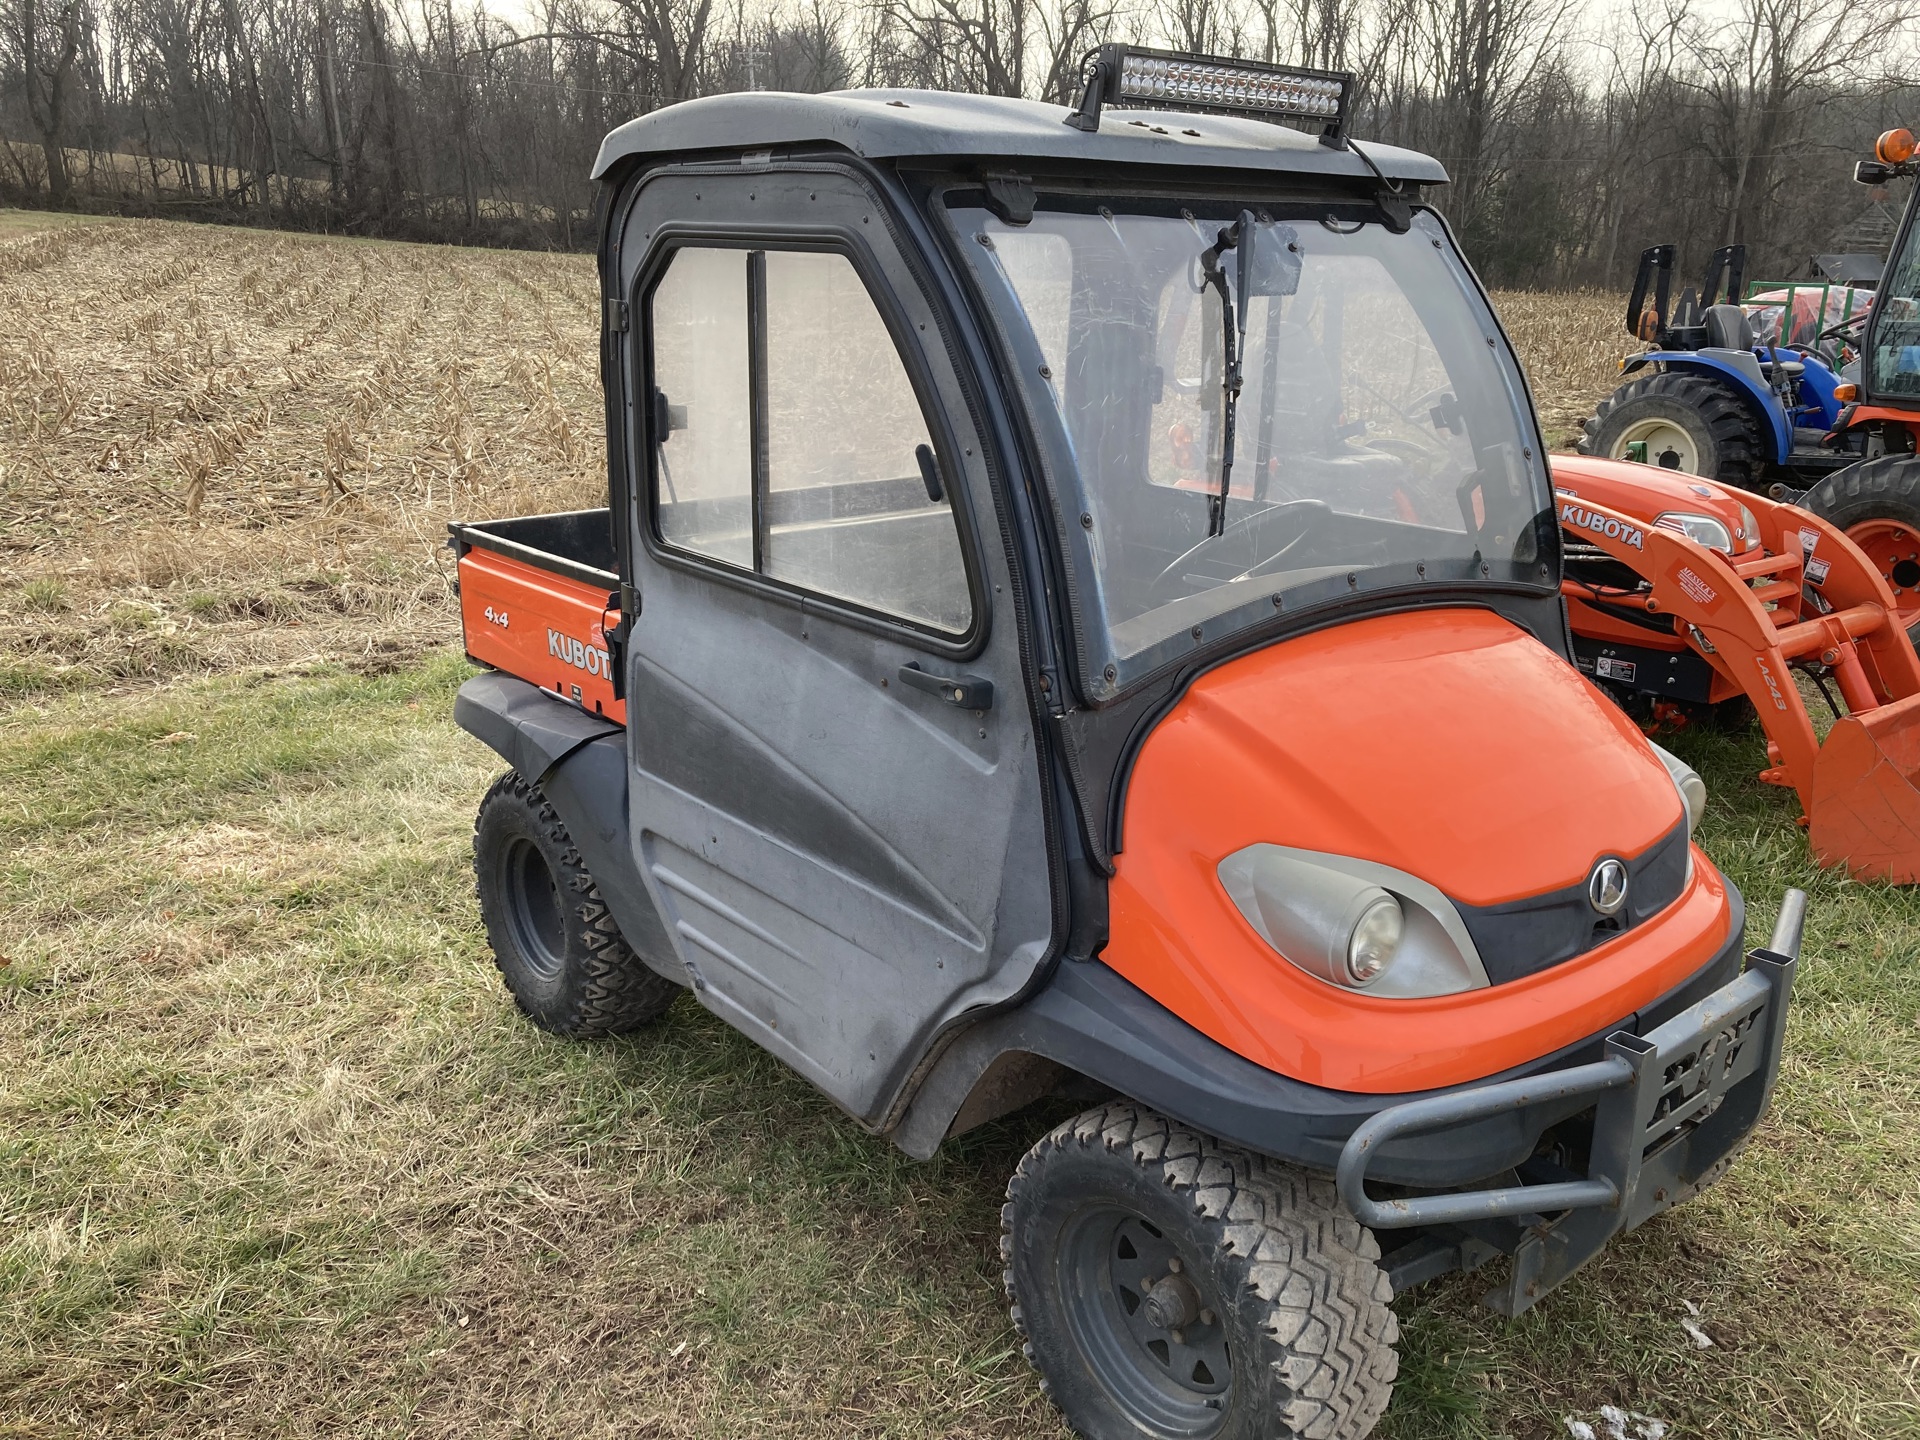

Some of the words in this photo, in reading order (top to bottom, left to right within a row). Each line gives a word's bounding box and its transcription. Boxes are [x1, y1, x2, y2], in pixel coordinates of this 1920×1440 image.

[1561, 504, 1643, 550] KUBOTA
[1681, 566, 1717, 598] MESSICK'S
[484, 605, 509, 629] 4x4
[547, 627, 613, 682] KUBOT
[1756, 657, 1787, 710] LA243
